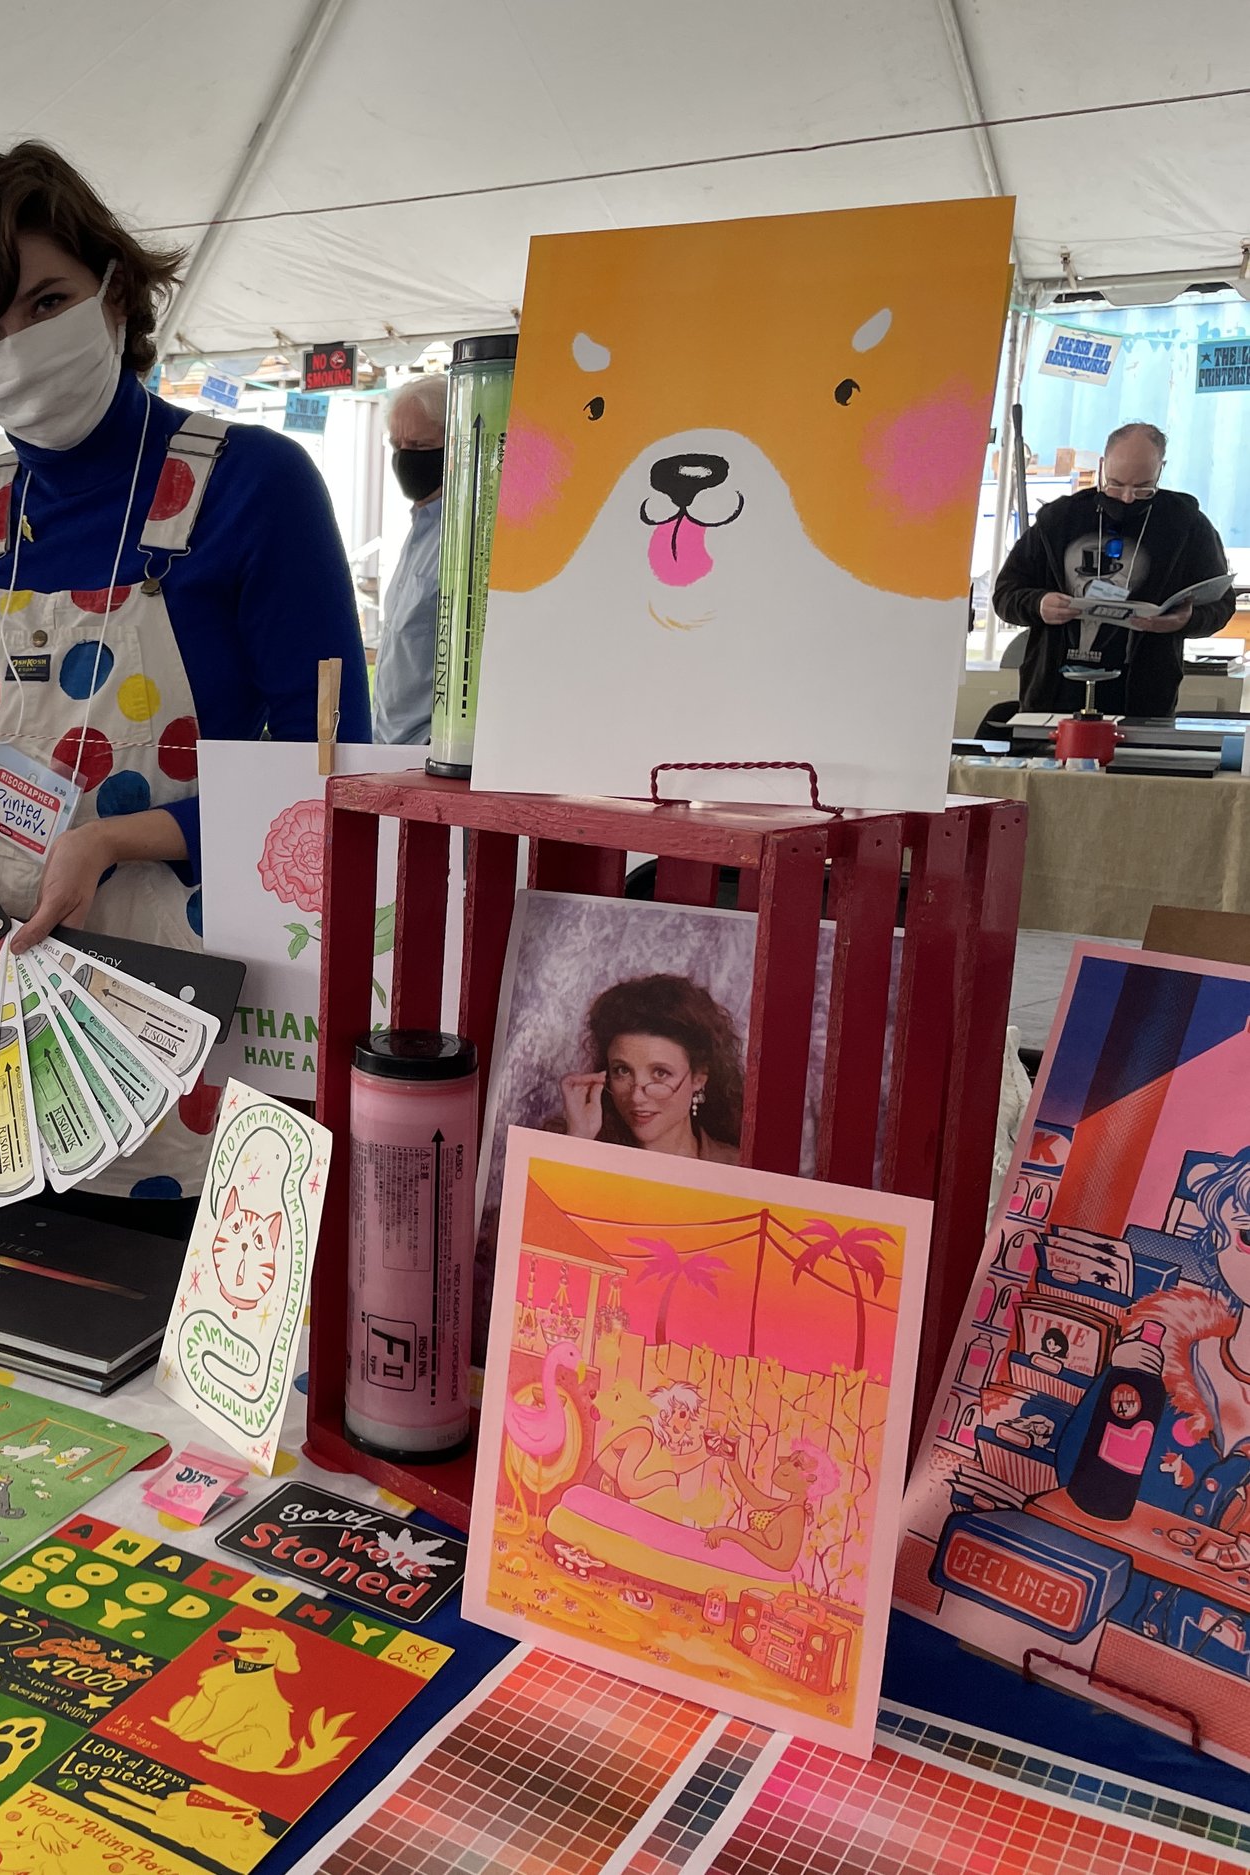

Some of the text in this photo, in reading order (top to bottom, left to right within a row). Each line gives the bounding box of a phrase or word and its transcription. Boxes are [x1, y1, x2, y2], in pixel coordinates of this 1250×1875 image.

[312, 353, 327, 370] NO
[1214, 347, 1237, 367] THE
[306, 369, 352, 388] SMOKING
[1199, 366, 1245, 388] PRINTERS
[435, 595, 450, 708] RISOINK
[0, 770, 56, 808] RISOGRAPHER
[44, 943, 61, 957] GOLD
[17, 963, 34, 990] GREEN
[139, 1024, 182, 1053] RISOINK
[235, 1006, 319, 1043] THAN
[244, 1046, 316, 1073] HAVE A
[53, 1106, 79, 1151] RISOINK
[1029, 1131, 1059, 1165] K
[1029, 1313, 1091, 1349] TIME
[369, 1355, 378, 1375] type
[418, 1335, 428, 1378] RISO INK
[174, 1465, 219, 1488] Dime
[278, 1502, 384, 1531] Sorry
[240, 1522, 434, 1611] Stoned
[952, 1544, 1072, 1617] DECLINED
[31, 1546, 214, 1622] GOOD
[0, 1564, 147, 1646] BOY.
[405, 1640, 441, 1663] of
[51, 1659, 129, 1693] 9000
[81, 1739, 129, 1765] LOOK
[58, 1751, 167, 1793] Leggies!!
[17, 1789, 81, 1825] Proper
[74, 1818, 134, 1866] Petting
